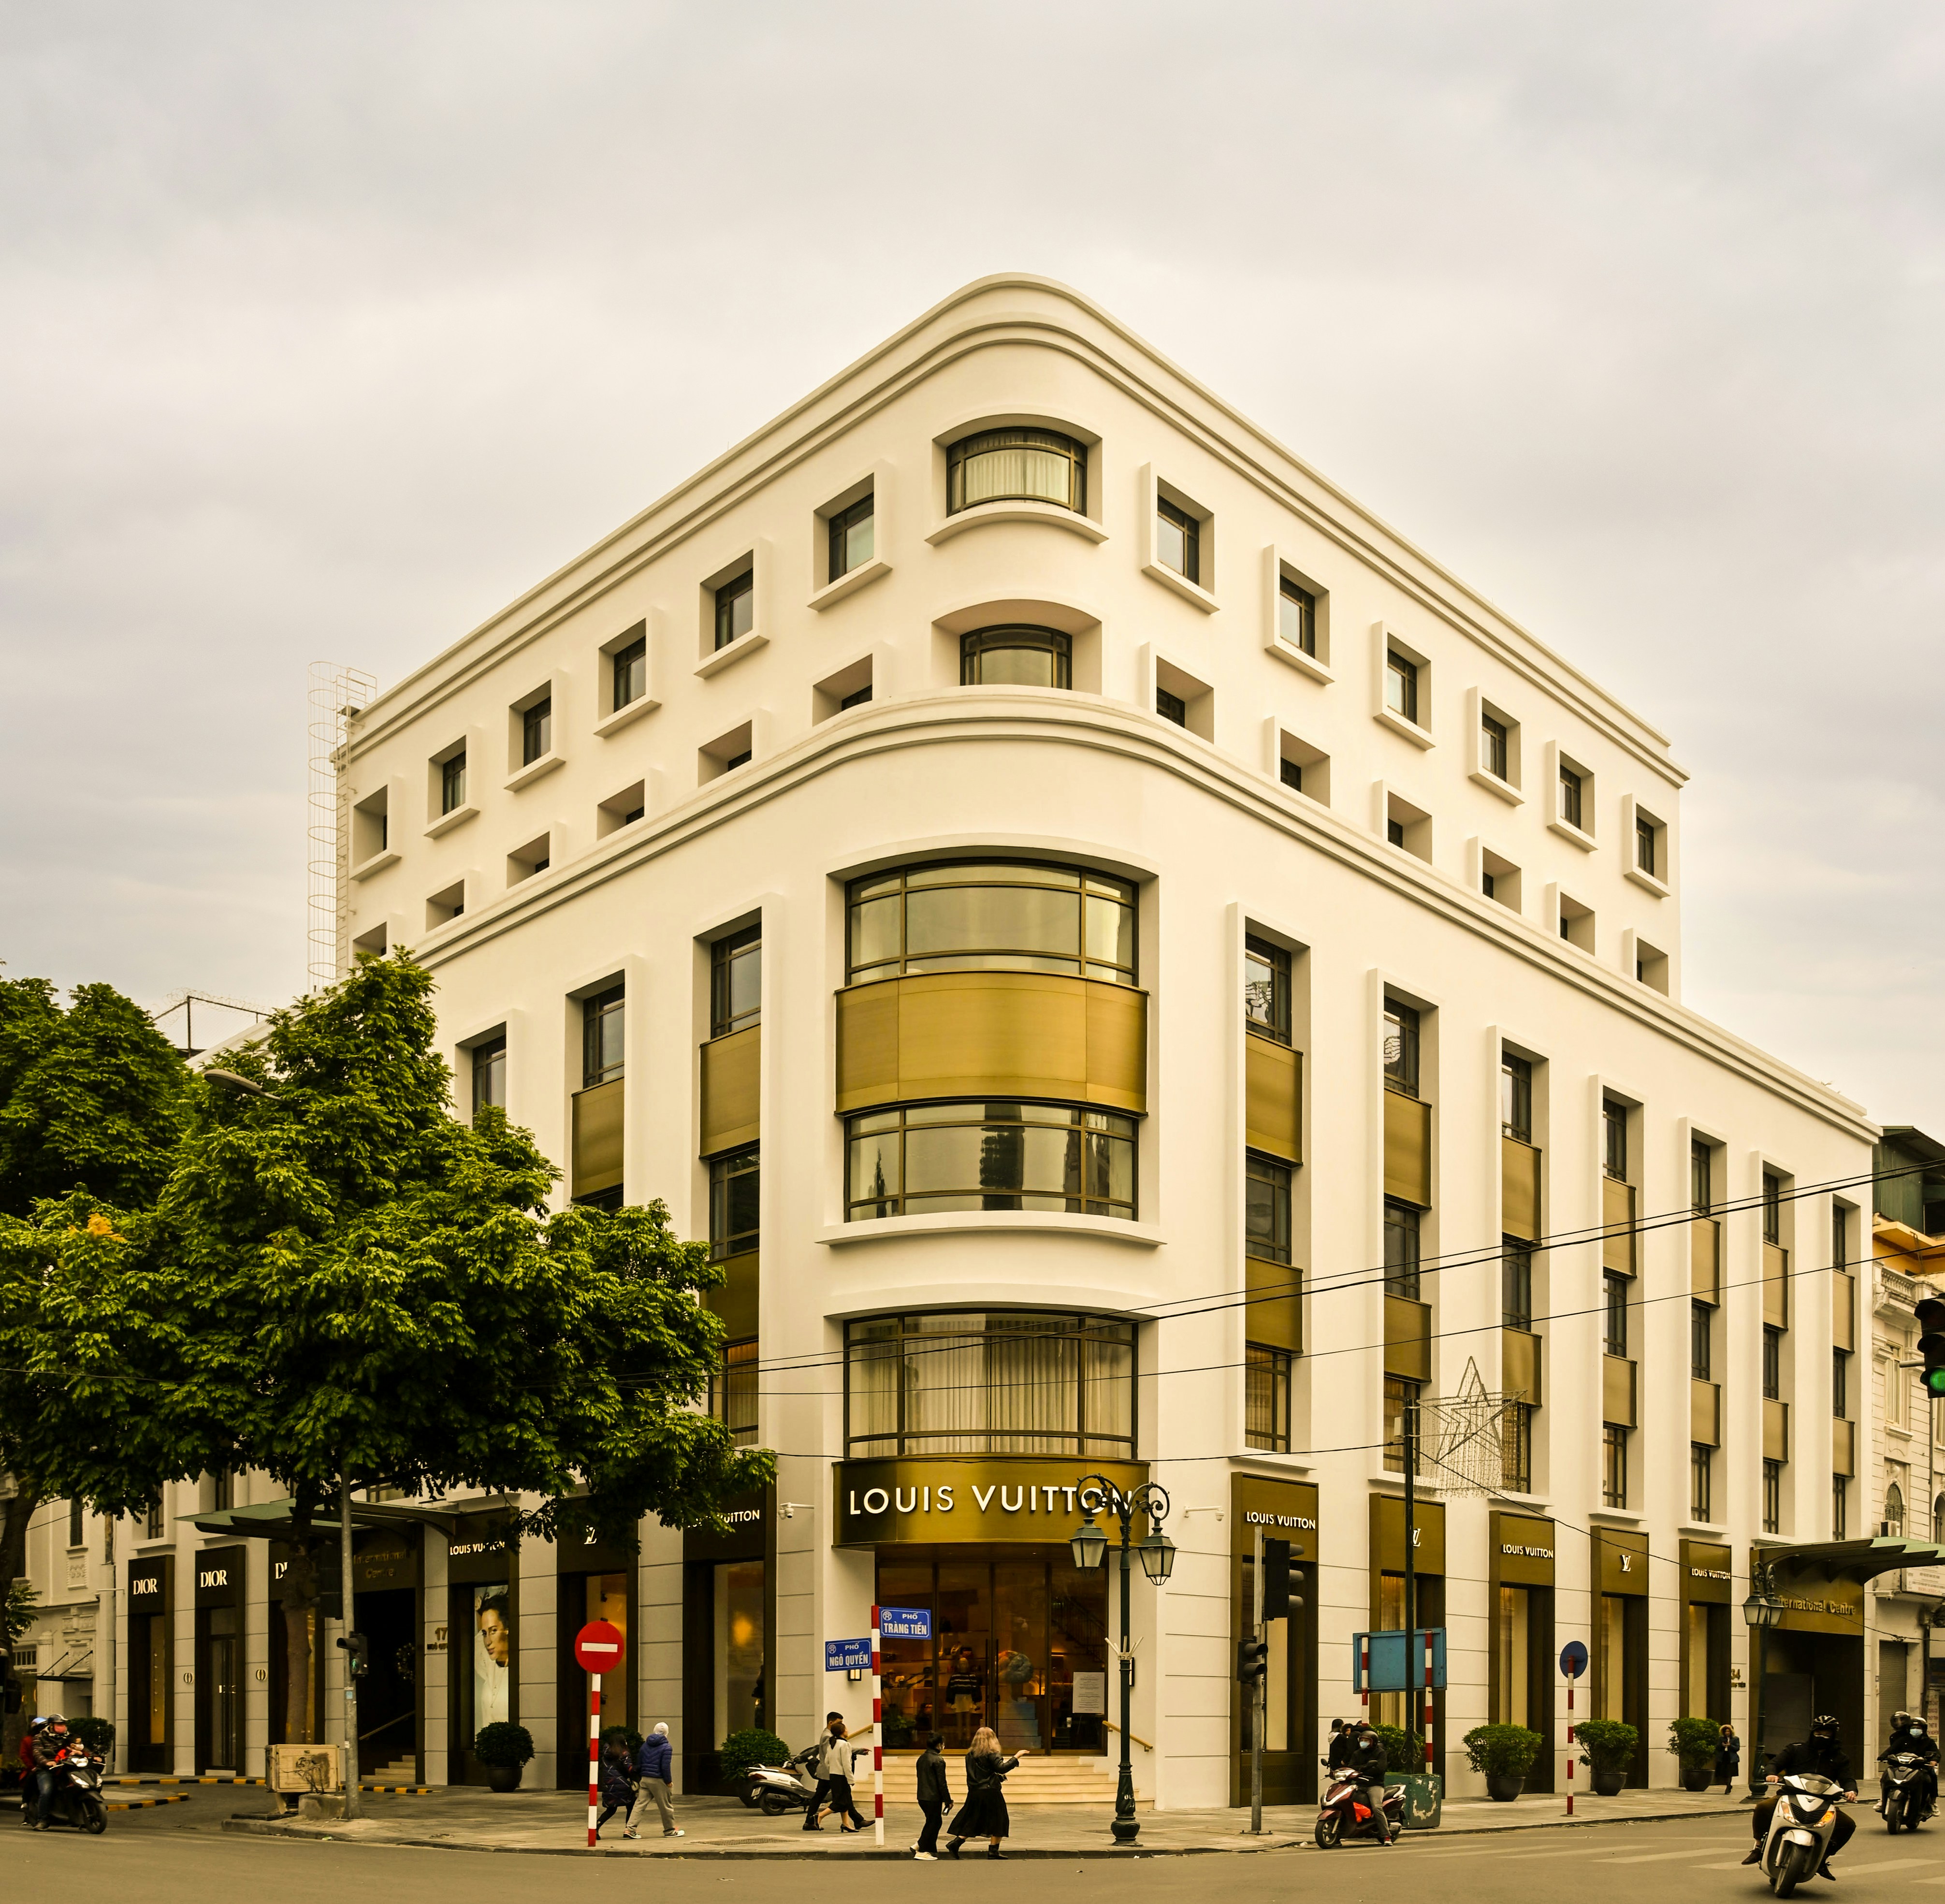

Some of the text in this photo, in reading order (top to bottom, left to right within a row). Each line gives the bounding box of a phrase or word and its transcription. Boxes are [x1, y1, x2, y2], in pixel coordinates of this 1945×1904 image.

[850, 1485, 1132, 1515] LOUIS VUITTON
[717, 1510, 760, 1523] UITTON
[1247, 1511, 1315, 1529] LOUIS VUITTON
[450, 1544, 471, 1555] LOUIS
[1503, 1544, 1553, 1558] LOUIS VUITTON
[200, 1570, 228, 1587] DIOR
[1692, 1568, 1730, 1580] LOUIS VUITTON
[133, 1578, 158, 1595] DIOR
[1829, 1600, 1857, 1615] Centre
[435, 1627, 448, 1641] 17
[884, 1621, 909, 1634] TRÀNG
[845, 1642, 860, 1650] PHỐ
[829, 1654, 843, 1666] NGÔ
